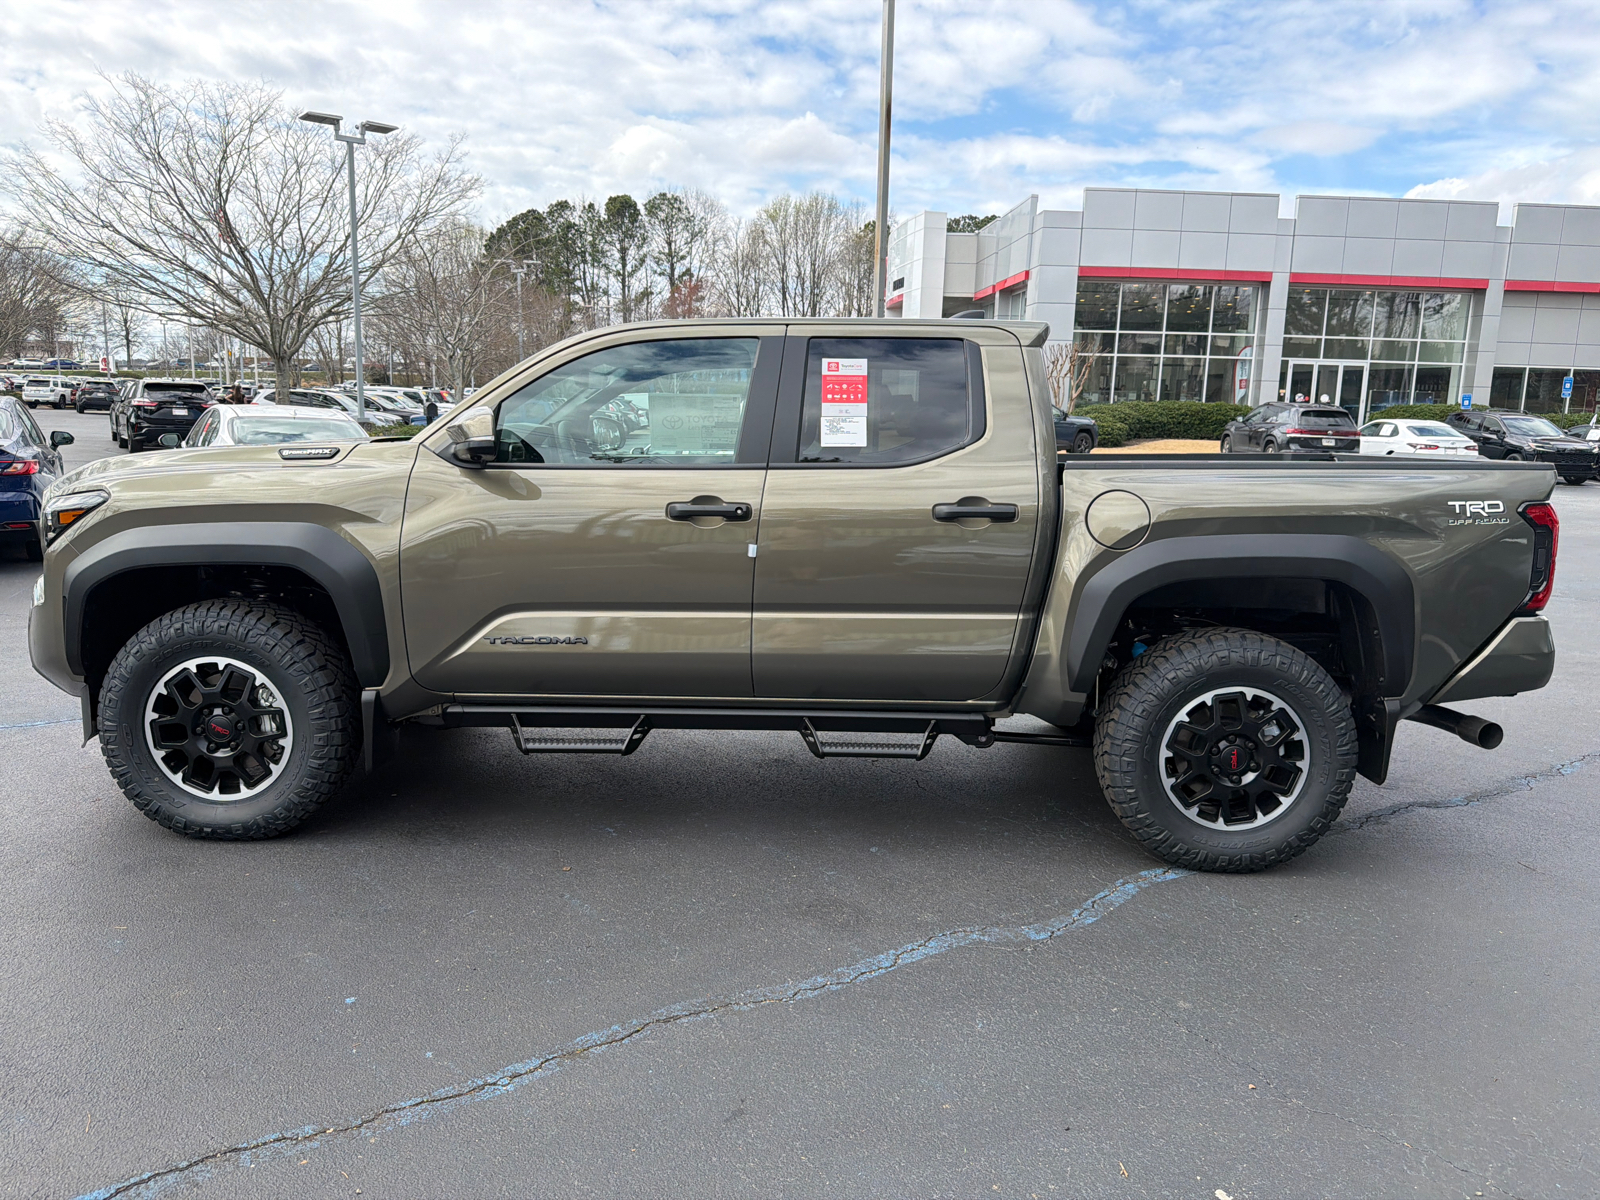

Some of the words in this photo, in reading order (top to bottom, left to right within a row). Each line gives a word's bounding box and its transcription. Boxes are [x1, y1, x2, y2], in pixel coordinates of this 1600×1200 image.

[686, 415, 728, 423] TOYOTA
[1447, 500, 1504, 517] TRD
[1475, 517, 1509, 525] ROAD
[484, 636, 588, 645] TACOMA
[210, 722, 230, 735] TRD
